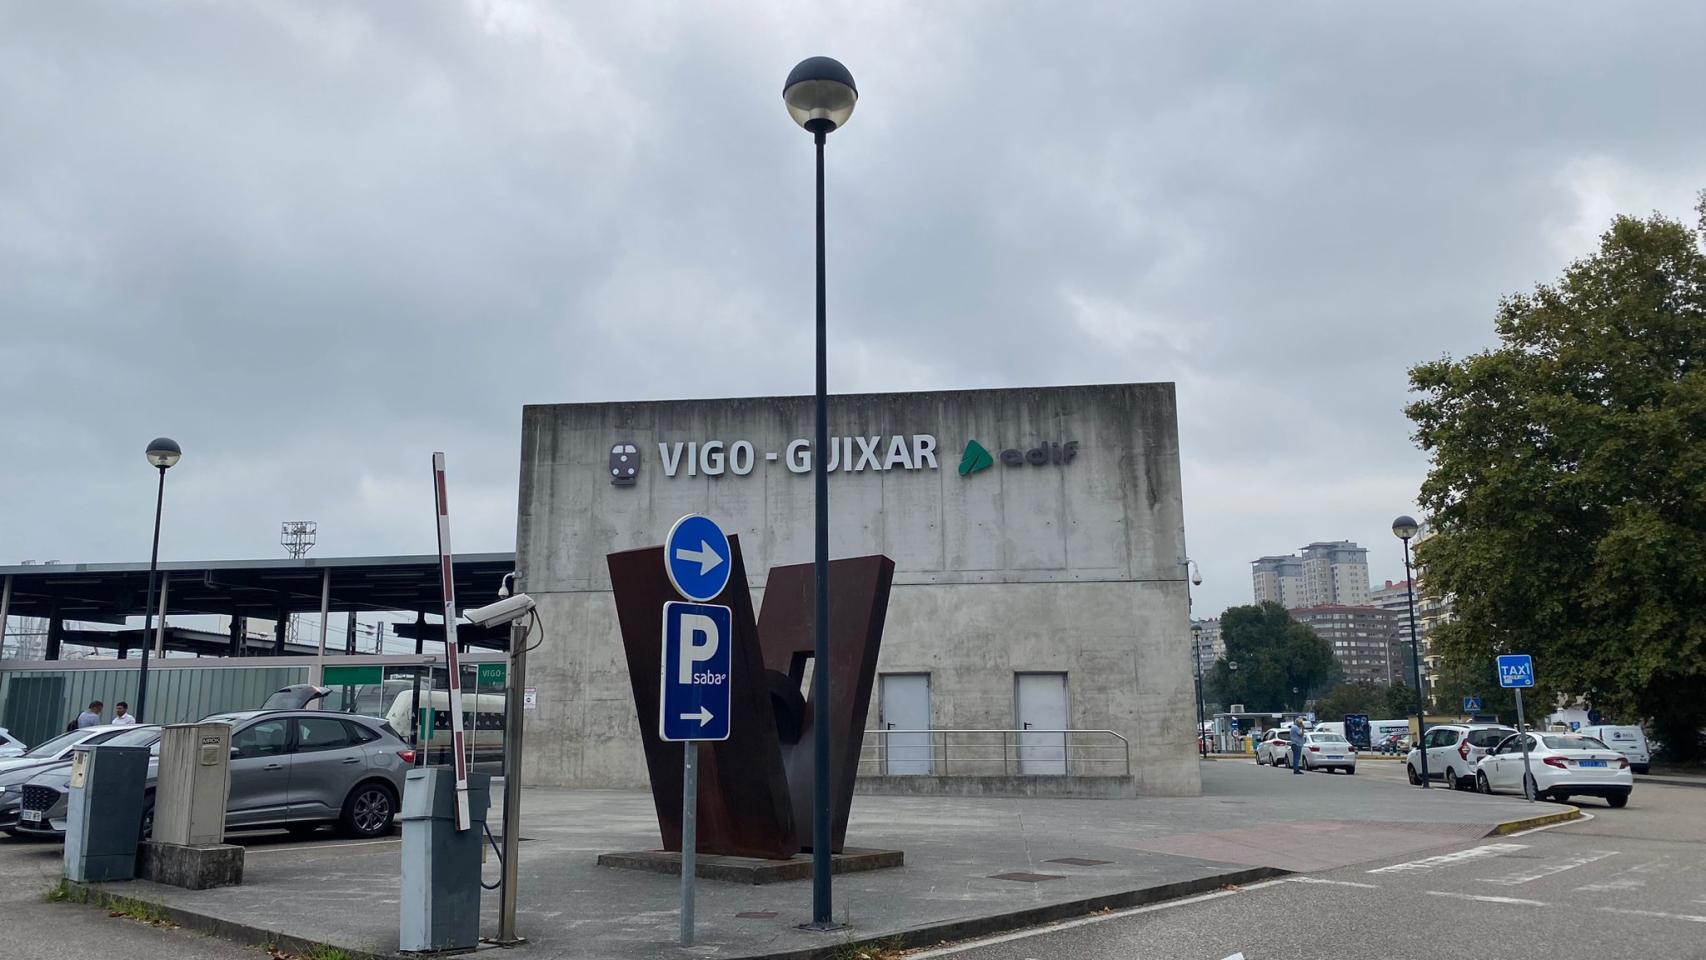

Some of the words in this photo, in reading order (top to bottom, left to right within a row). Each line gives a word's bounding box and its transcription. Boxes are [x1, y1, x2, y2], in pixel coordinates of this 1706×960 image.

[658, 440, 754, 476] VIGO
[785, 434, 938, 473] GUIXAR
[679, 613, 719, 684] P
[482, 669, 501, 678] VIGO
[1501, 663, 1530, 675] TAXI
